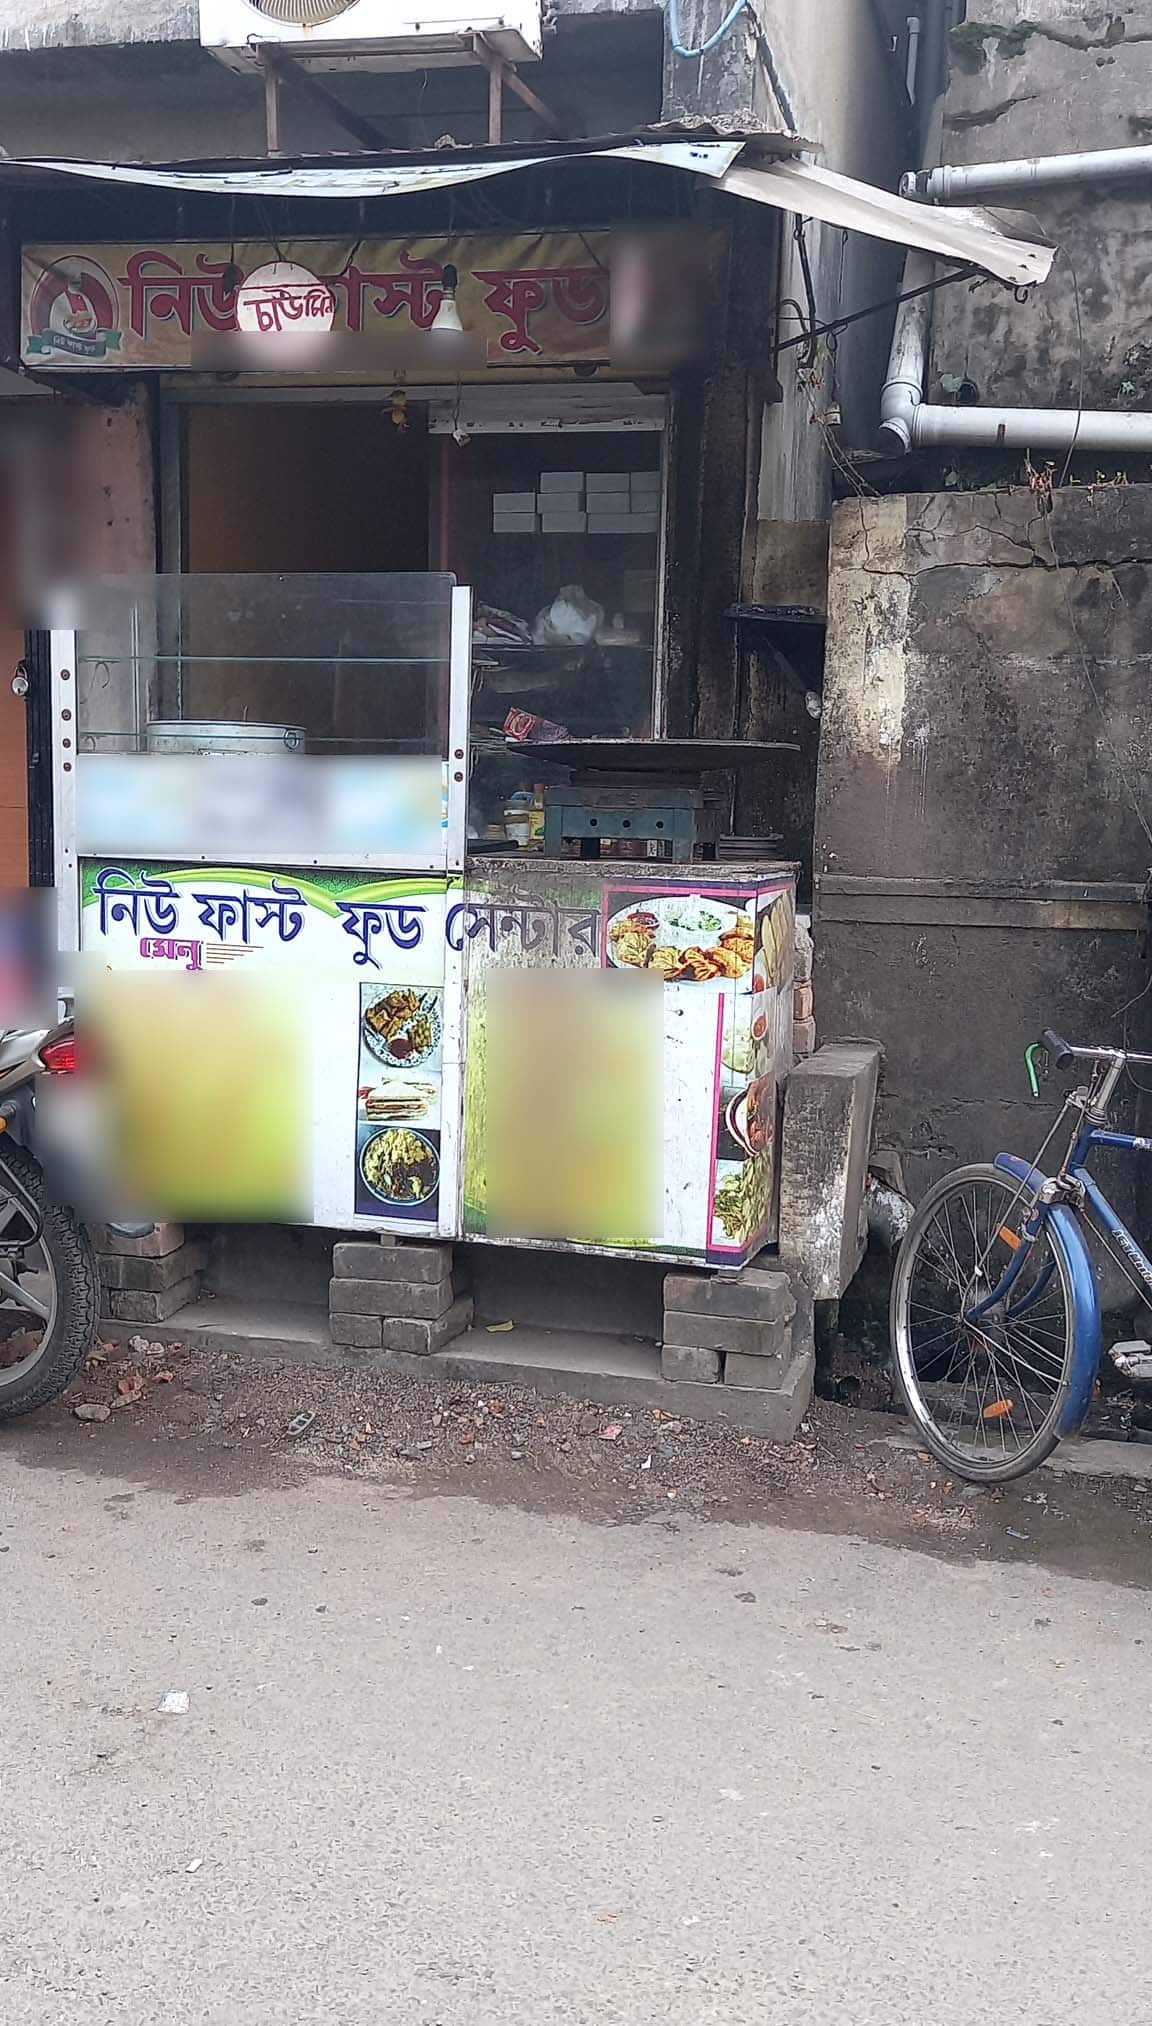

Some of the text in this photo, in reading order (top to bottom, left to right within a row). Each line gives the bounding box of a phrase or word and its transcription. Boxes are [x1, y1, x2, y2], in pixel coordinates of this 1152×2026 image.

[117, 250, 243, 338] নিউ
[471, 268, 609, 353] ফুড
[93, 867, 601, 969] নিউ ফাস্ট ফুড সেন্টার
[140, 937, 203, 970] মেনু
